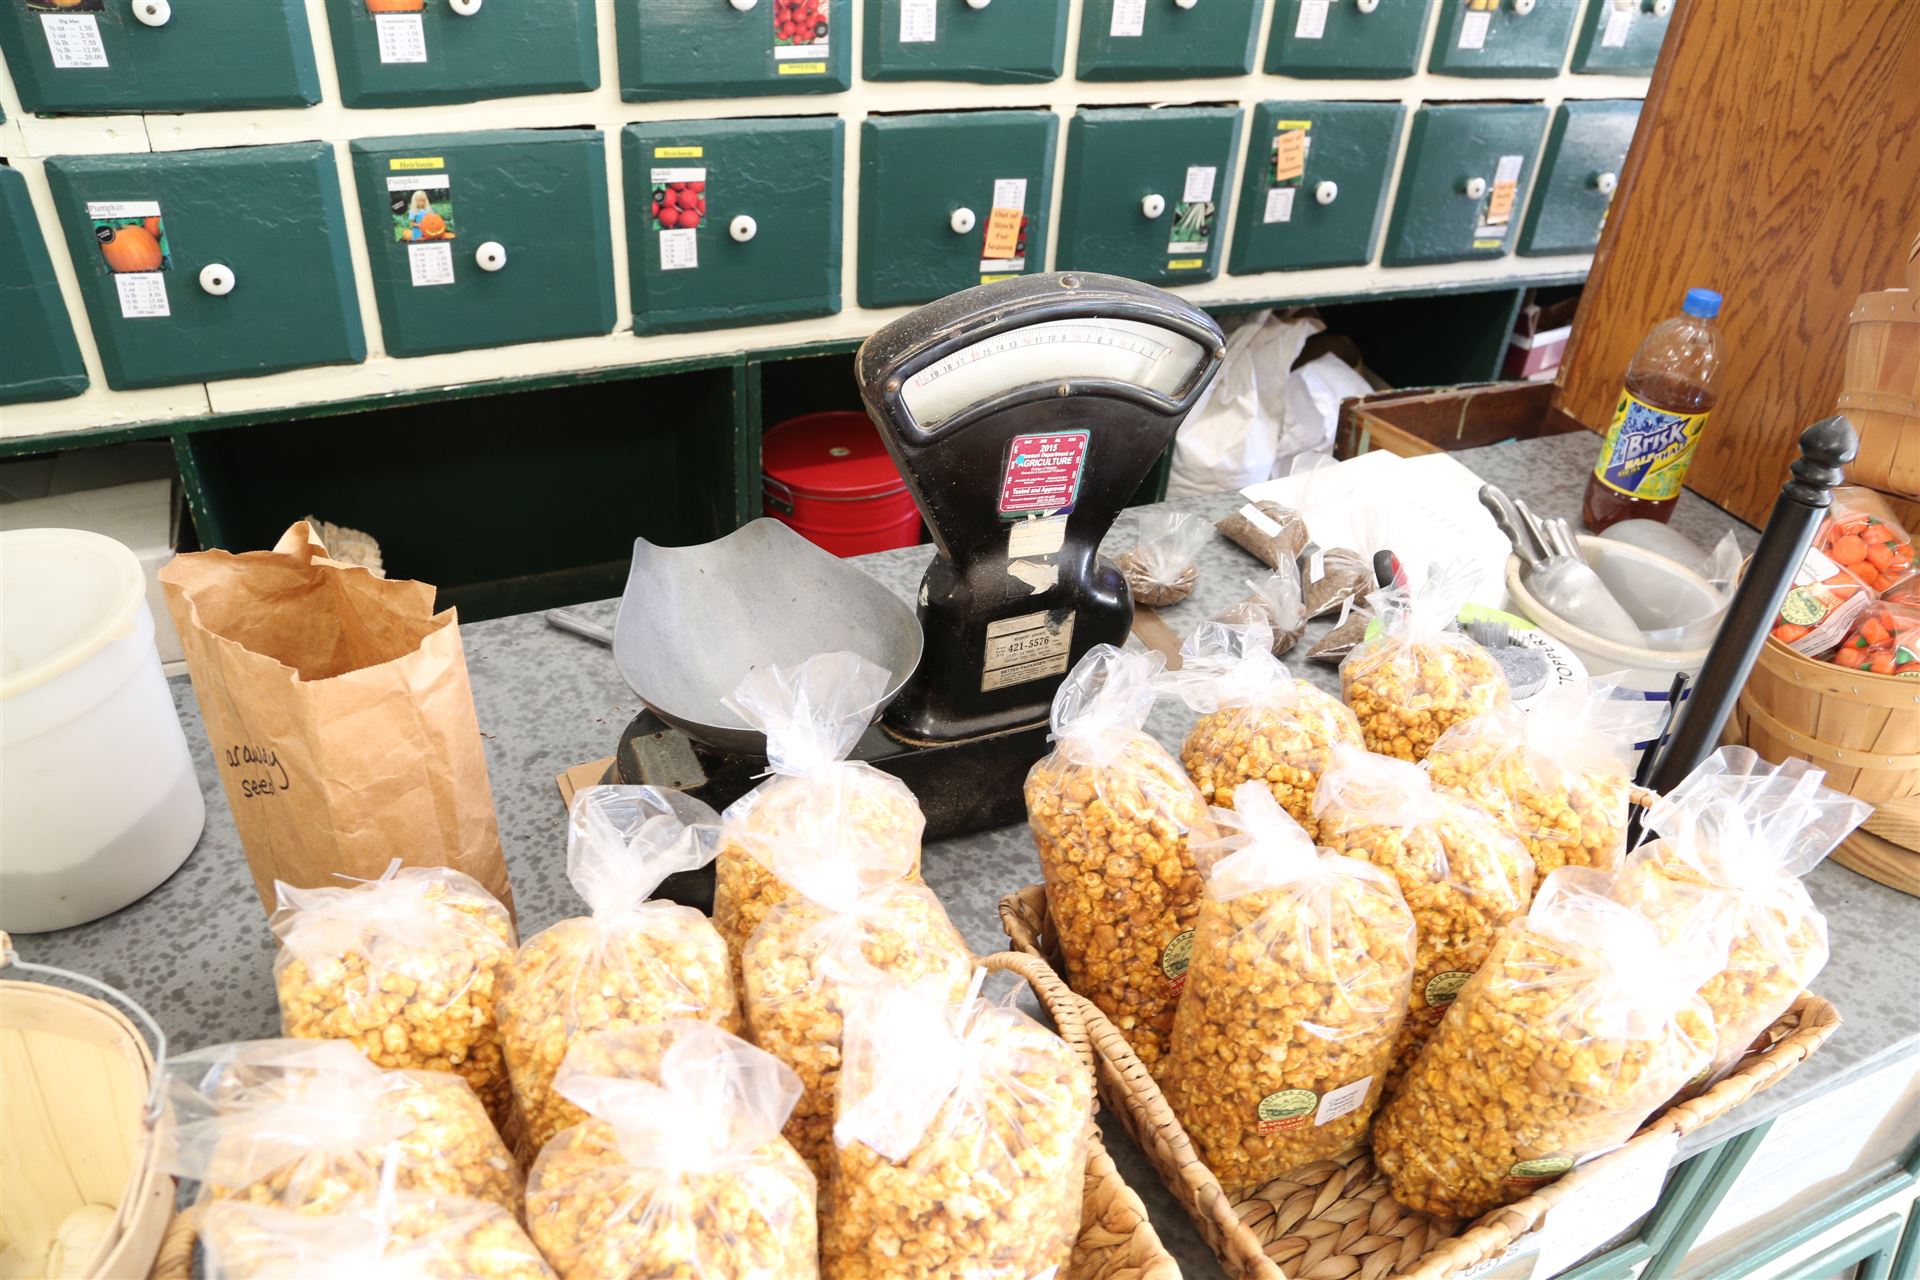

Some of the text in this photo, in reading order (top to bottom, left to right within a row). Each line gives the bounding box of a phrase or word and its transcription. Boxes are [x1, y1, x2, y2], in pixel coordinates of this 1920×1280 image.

[89, 203, 124, 214] Pumpkin
[930, 370, 939, 380] 19
[943, 364, 952, 373] 18
[956, 358, 965, 366] 17
[1040, 444, 1058, 452] 2015
[1018, 457, 1073, 467] AGRICULTURE
[1041, 485, 1066, 493] Approved
[1008, 636, 1049, 652] 421-5576
[1529, 633, 1574, 685] TOPPERS
[241, 770, 275, 798] seed
[1428, 973, 1456, 1001] PLANTERS
